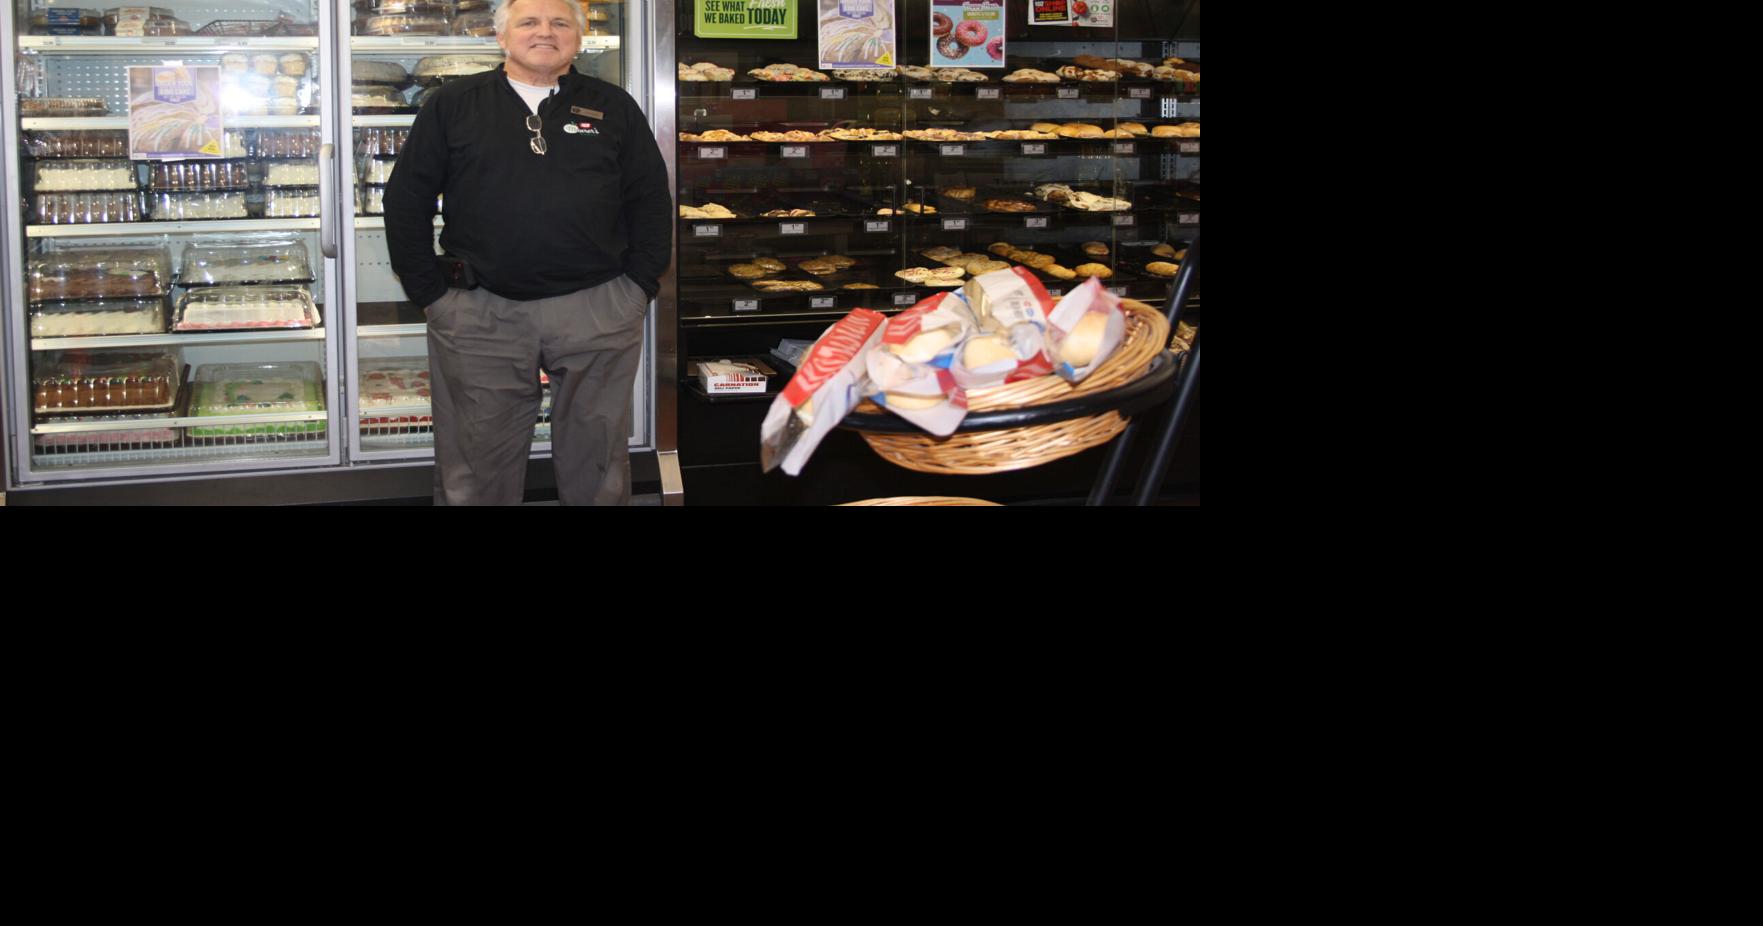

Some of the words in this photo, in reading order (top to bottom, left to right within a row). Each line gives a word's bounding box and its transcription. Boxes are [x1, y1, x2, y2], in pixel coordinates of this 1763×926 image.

[705, 1, 720, 12] SEE
[722, 1, 745, 12] WHAT
[704, 13, 717, 24] WE
[718, 13, 745, 25] BAKED
[746, 8, 787, 25] TODAY
